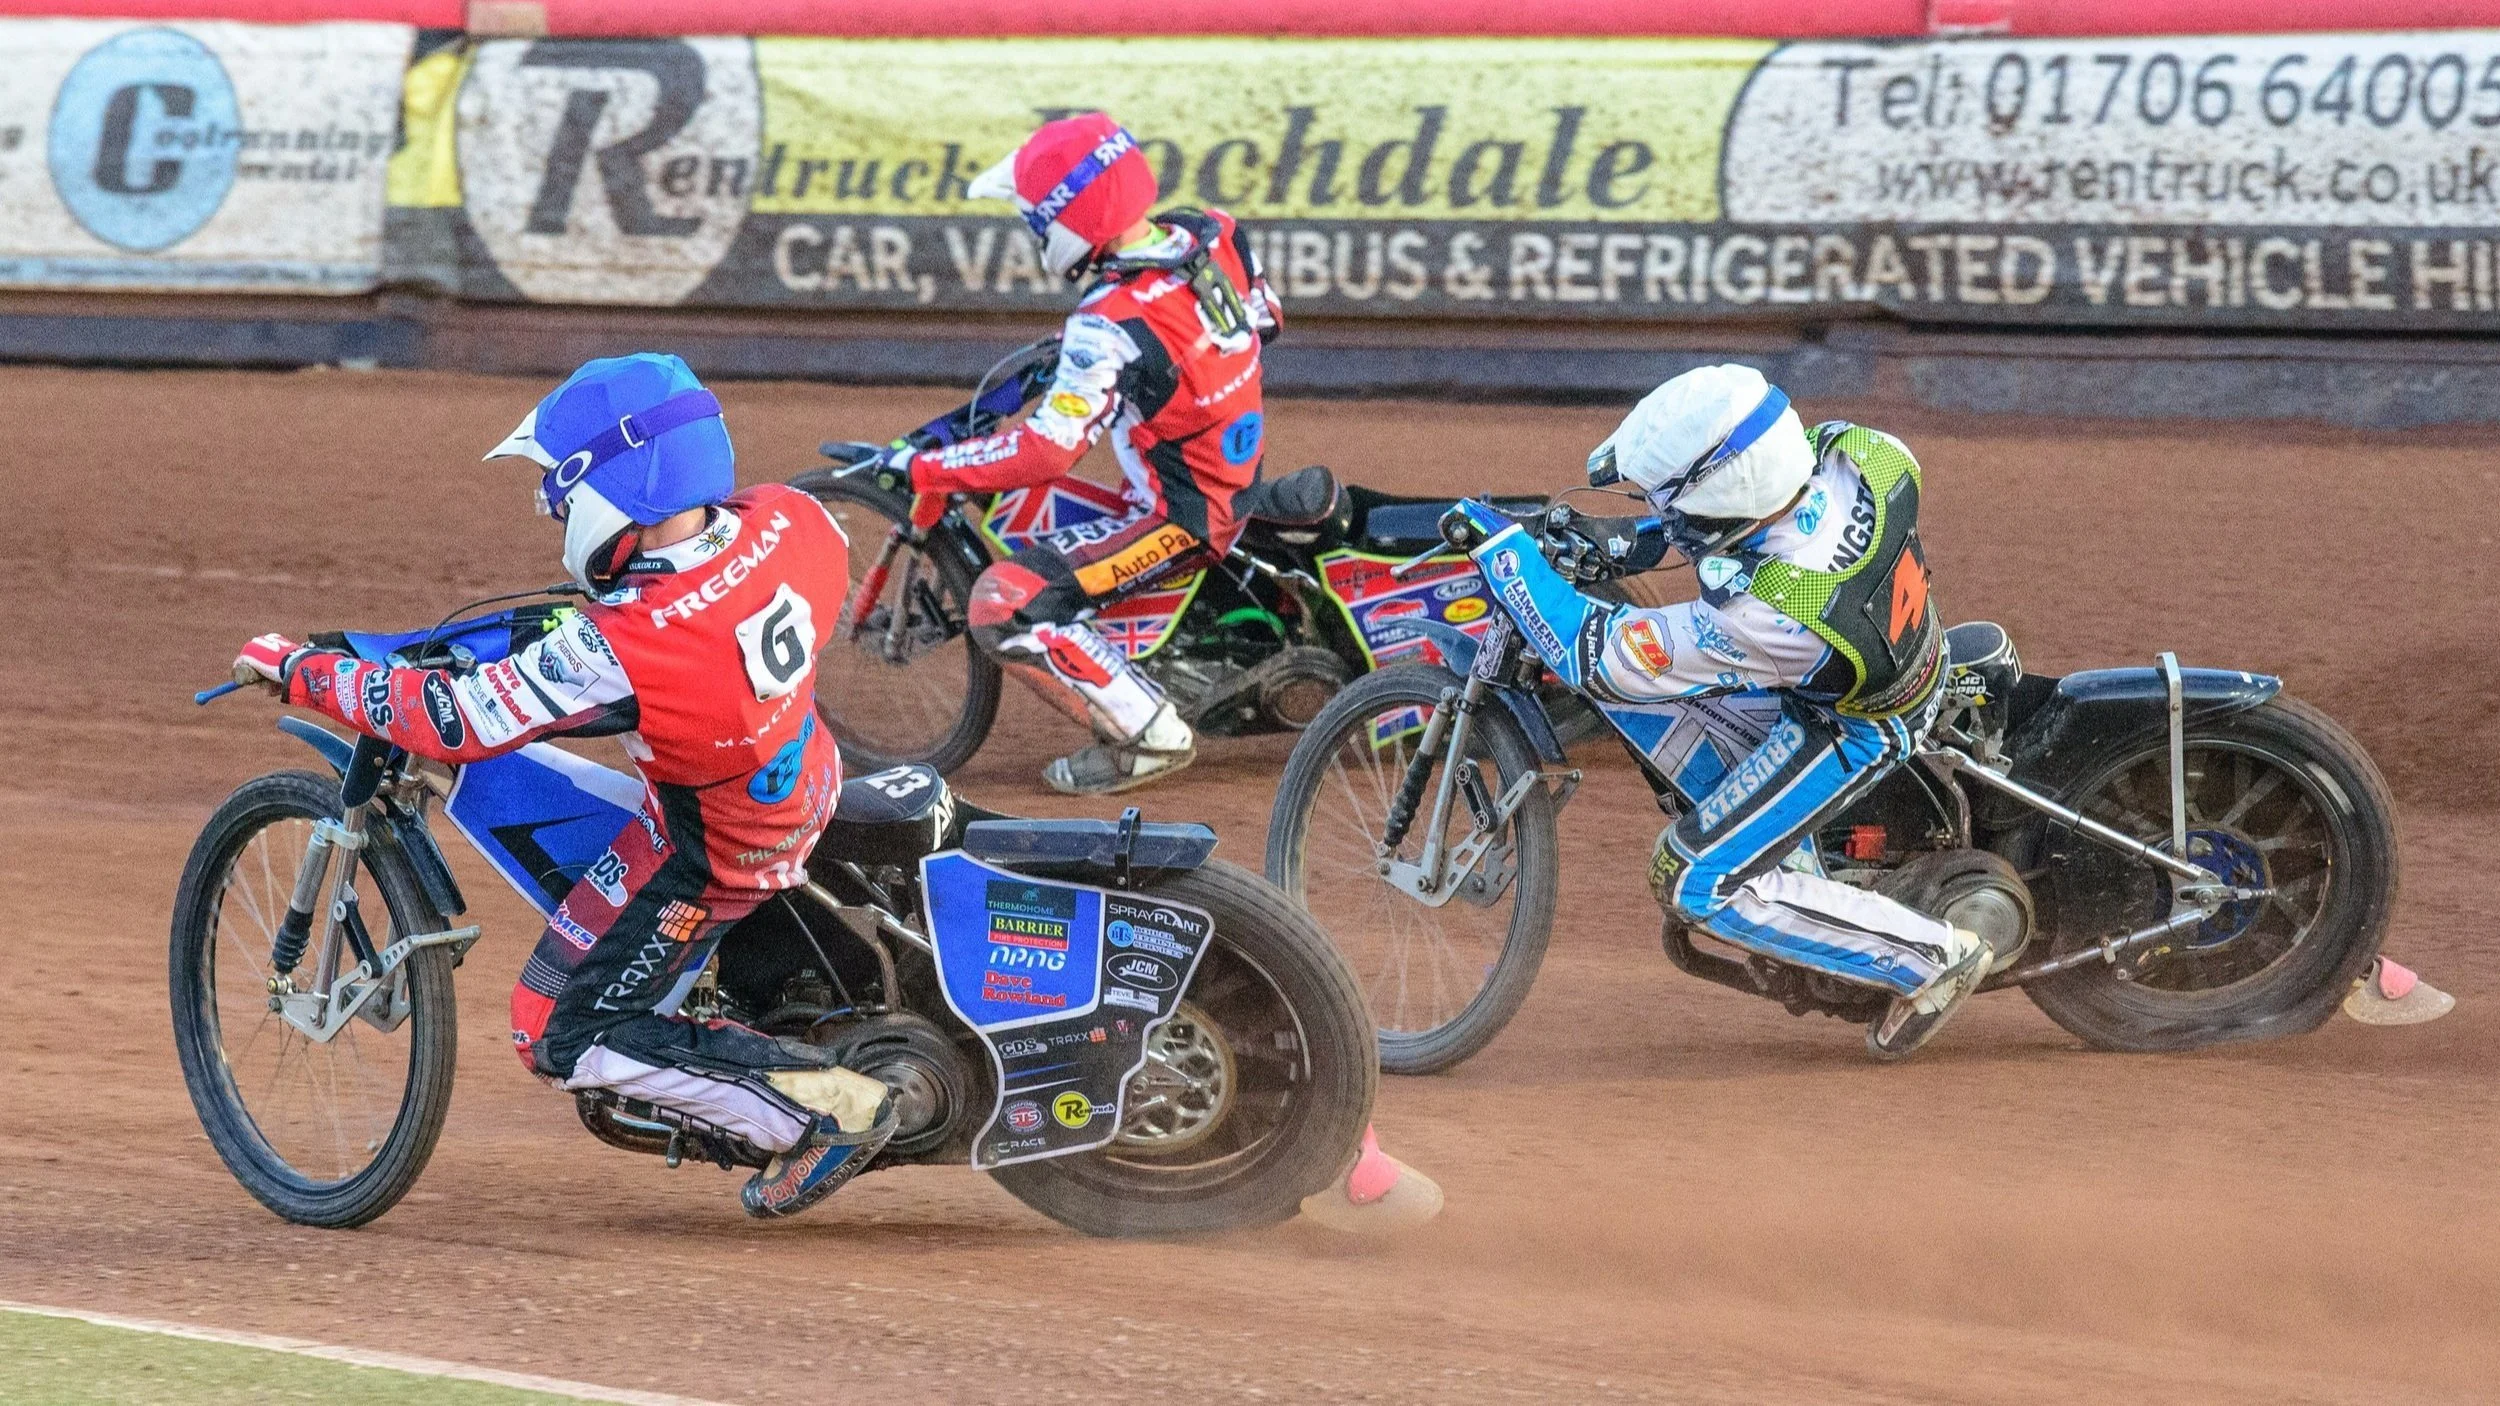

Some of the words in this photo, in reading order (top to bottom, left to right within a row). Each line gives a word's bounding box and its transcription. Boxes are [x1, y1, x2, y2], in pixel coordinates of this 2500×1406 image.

[1822, 54, 1961, 129] Tel:
[1986, 53, 2238, 128] 01706
[2260, 53, 2500, 128] 64005
[518, 37, 979, 236] Rentruck
[1033, 106, 1655, 210] ochdale
[1876, 145, 2498, 204] www.rentruck.co.uk
[773, 225, 936, 302] CAR,
[946, 226, 1063, 294] VA
[1249, 229, 1429, 300] IBUS
[1444, 231, 1495, 301] &
[1510, 231, 2056, 305] REFRIGERATED
[2075, 236, 2397, 310] VEHICLE
[2411, 239, 2500, 312] HI
[650, 510, 791, 630] FREEMAN
[1111, 549, 1161, 584] Auto
[1505, 588, 1525, 615] TOOL
[1512, 579, 1566, 660] LAMBERTS
[554, 638, 583, 673] FRIENDS
[761, 599, 806, 683] 6
[367, 669, 394, 727] CDS
[435, 686, 456, 724] JCM
[864, 765, 931, 800] 23
[1700, 722, 1805, 832] CRUSELY
[988, 900, 1054, 916] THERMOHOME
[1109, 903, 1203, 935] SPRAYPLANT
[993, 933, 1012, 942] FIRE
[1012, 935, 1064, 948] PROTECTION
[994, 917, 1064, 937] BARRIER
[594, 933, 674, 1012] TRAXX
[985, 970, 1032, 989] Dave
[1126, 959, 1160, 976] JCM
[983, 986, 1067, 1007] Rowland
[1001, 1038, 1038, 1055] CDS
[1048, 1032, 1090, 1047] TRAXX
[1009, 1110, 1038, 1124] STS
